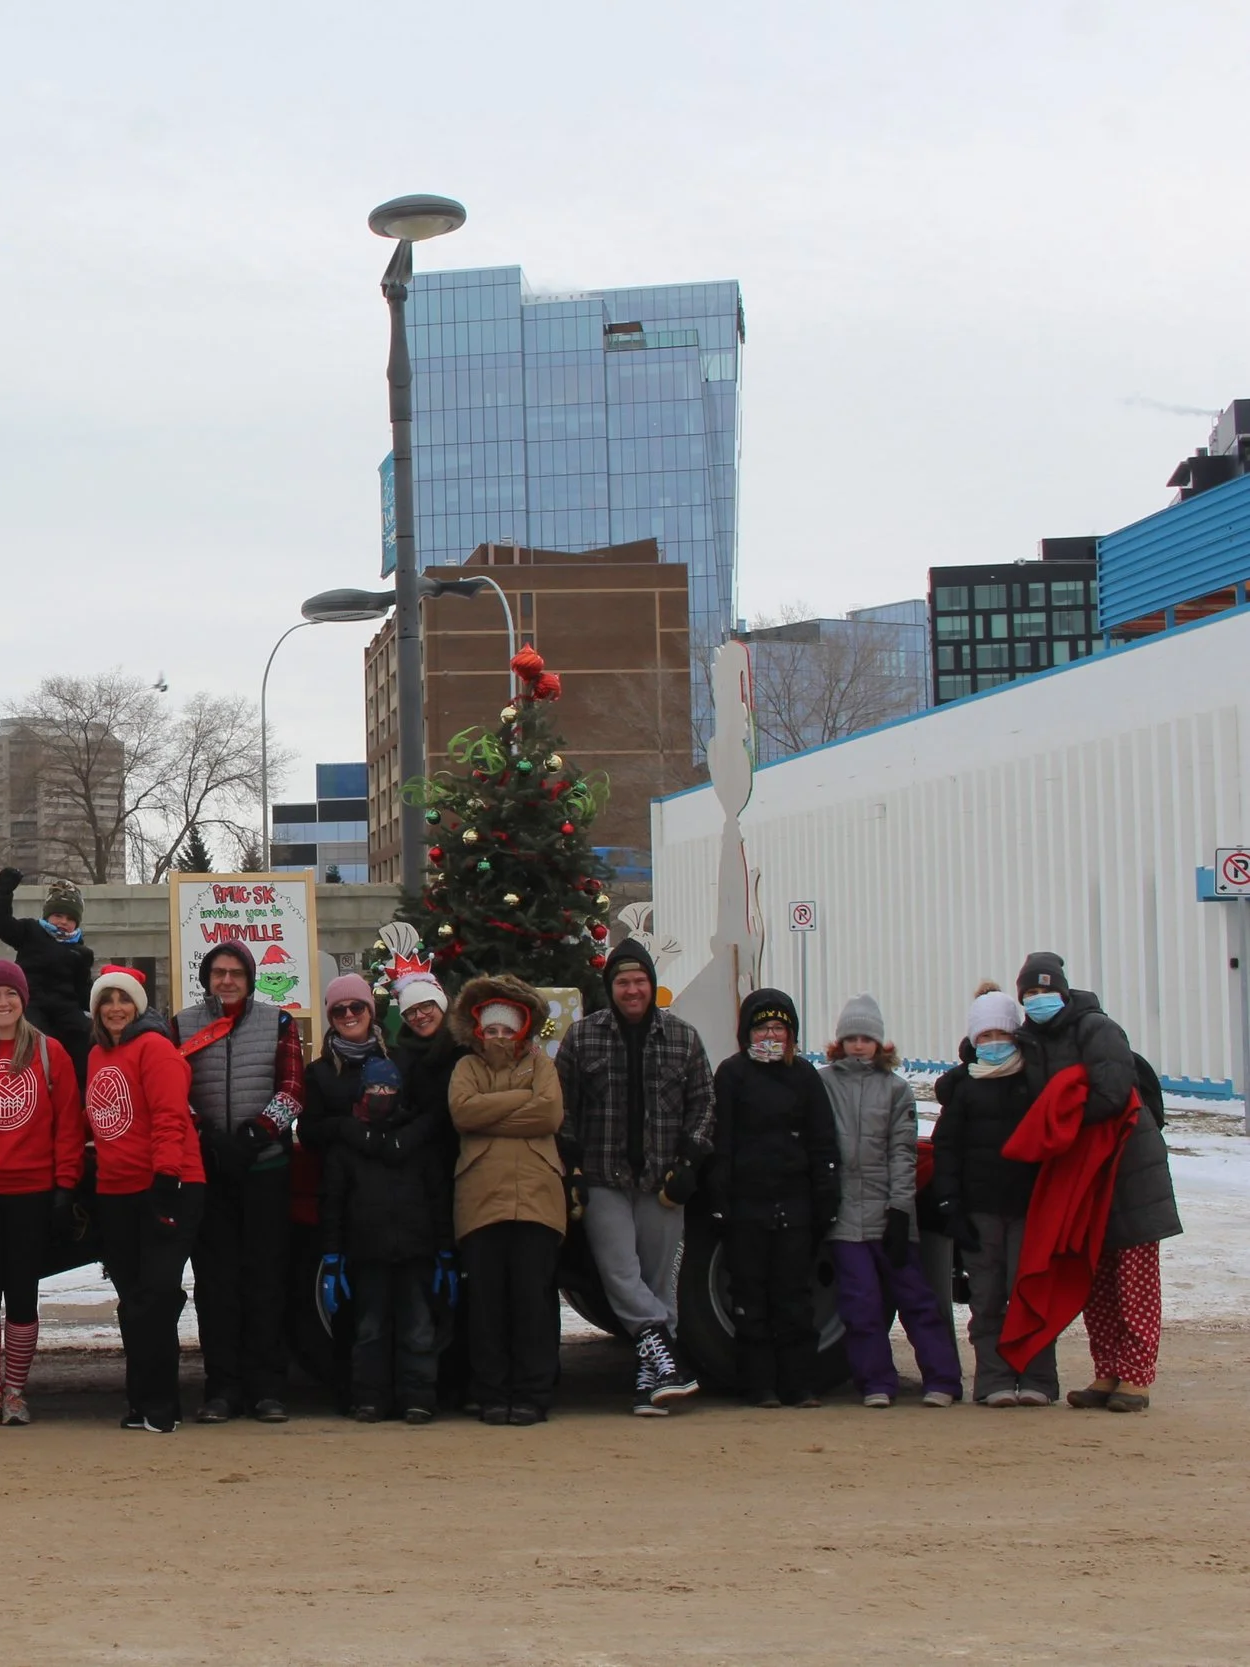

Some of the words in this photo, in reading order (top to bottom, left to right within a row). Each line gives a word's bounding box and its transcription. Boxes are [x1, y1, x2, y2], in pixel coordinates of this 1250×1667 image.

[212, 884, 276, 905] RMHC-SK
[200, 905, 239, 919] invites
[245, 908, 267, 923] you
[270, 905, 284, 917] to
[200, 922, 284, 943] WHOVILLE
